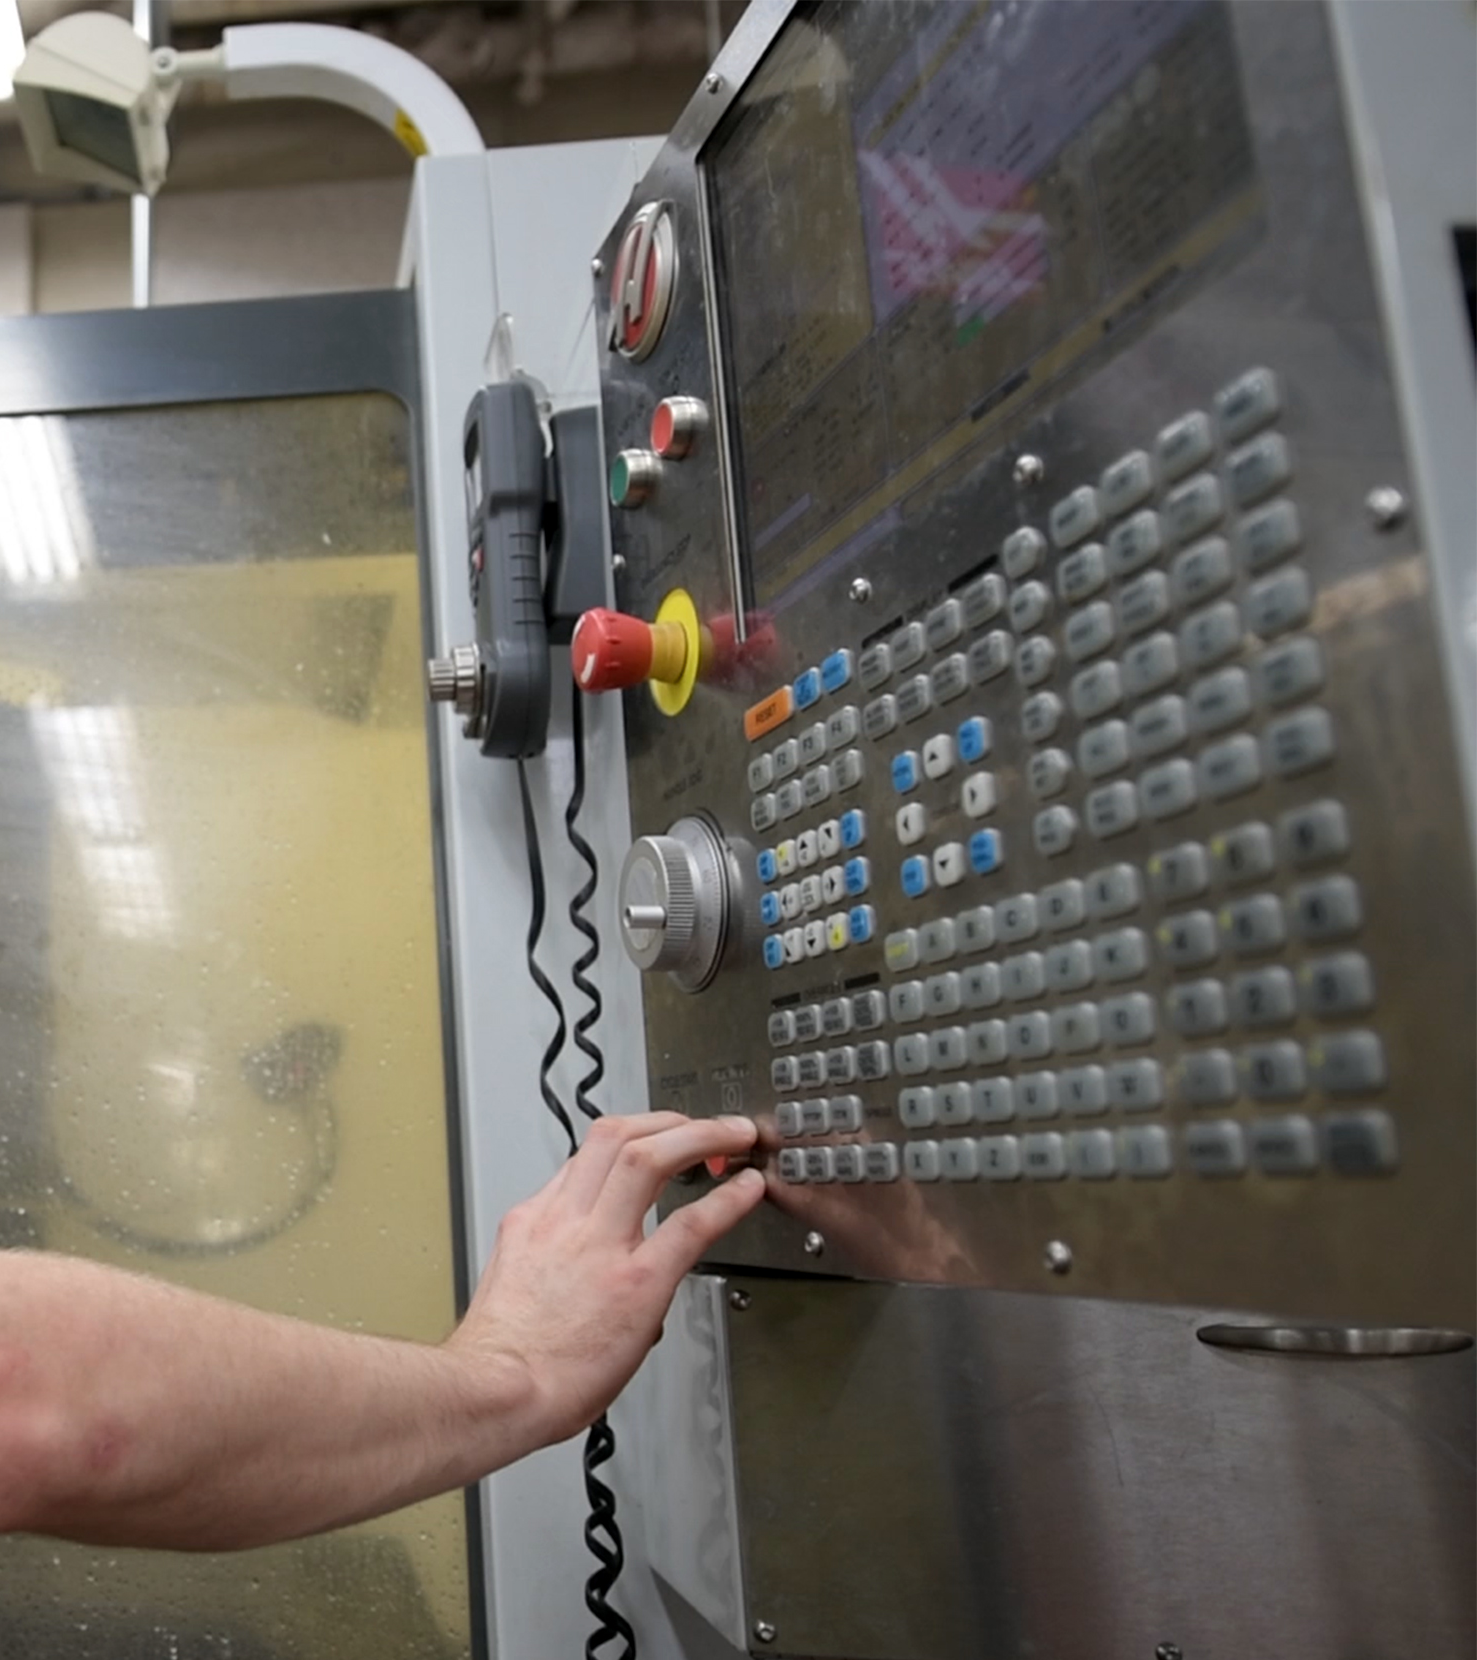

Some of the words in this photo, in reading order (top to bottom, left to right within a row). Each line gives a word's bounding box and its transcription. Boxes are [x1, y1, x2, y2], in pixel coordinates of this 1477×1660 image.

[755, 702, 776, 724] RESET
[777, 752, 787, 766] F2
[802, 736, 813, 750] F3
[831, 720, 842, 735] F4
[1006, 909, 1017, 927] C
[1051, 898, 1063, 916] D
[933, 986, 943, 1003] G
[1020, 1026, 1031, 1045] O
[908, 1098, 917, 1115] R
[944, 1095, 954, 1113] S
[983, 1090, 993, 1108] T
[1026, 1087, 1037, 1105] U
[1073, 1081, 1084, 1099] V
